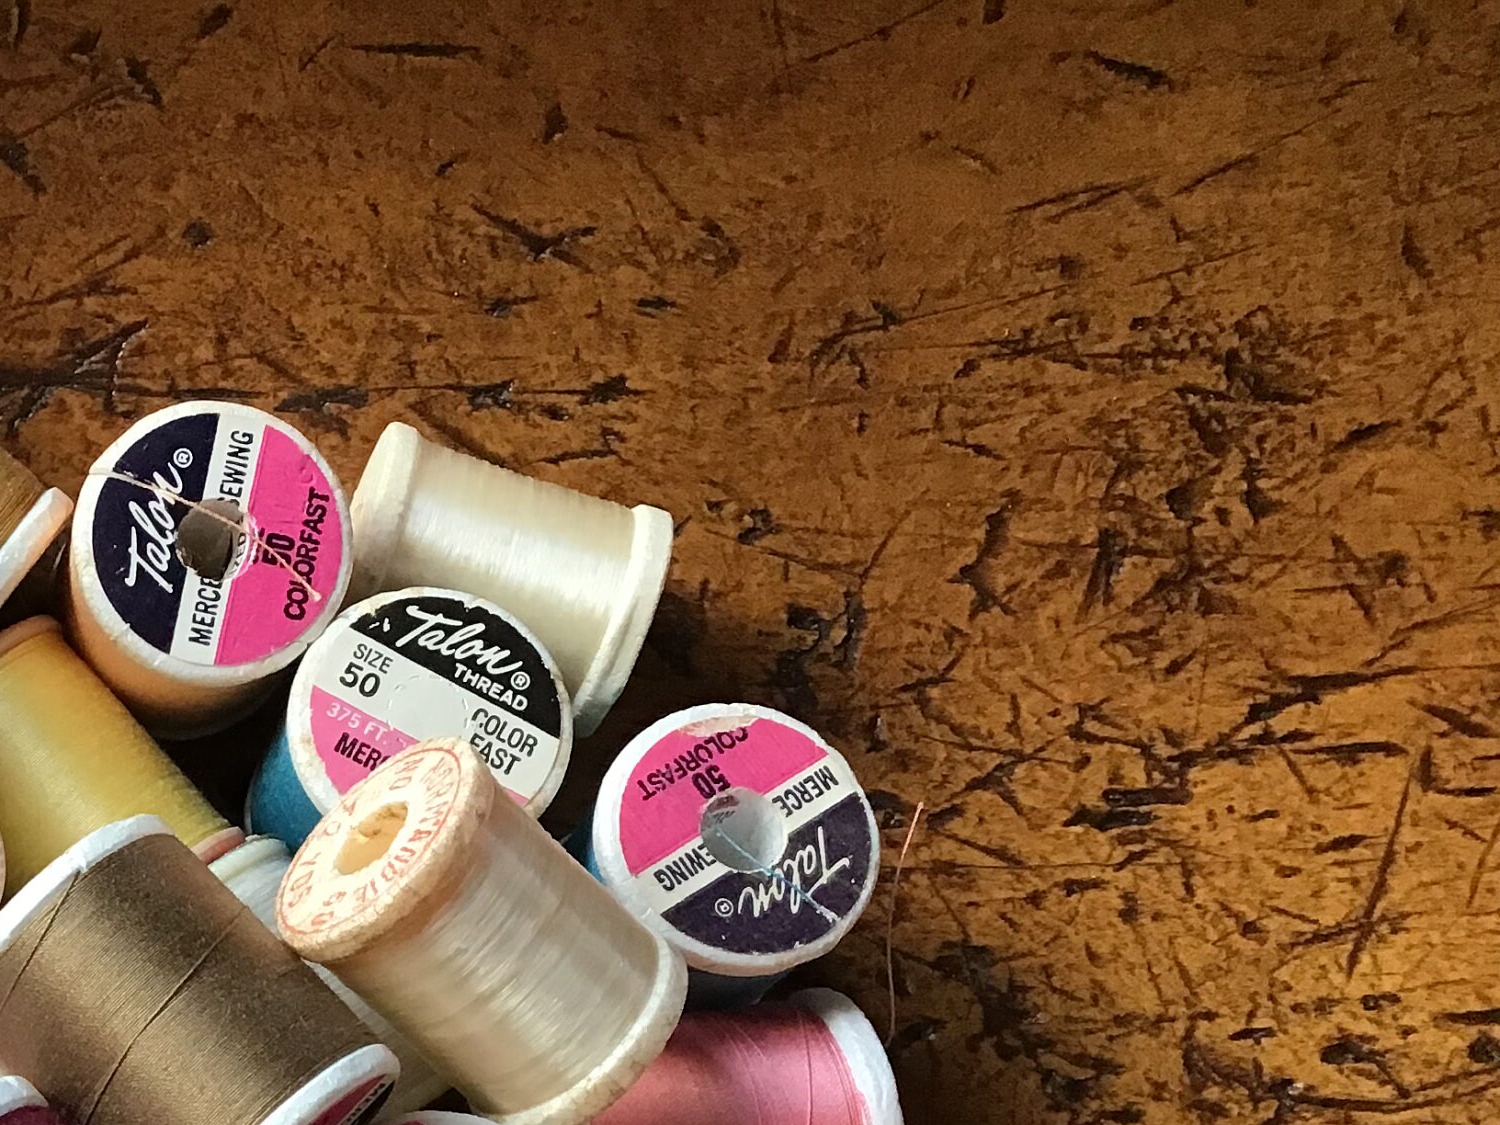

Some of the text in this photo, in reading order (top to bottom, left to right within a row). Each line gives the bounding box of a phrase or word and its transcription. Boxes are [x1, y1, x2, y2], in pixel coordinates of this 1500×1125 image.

[283, 488, 330, 620] COLORFAST
[339, 663, 381, 698] 50
[353, 643, 394, 675] SIZE
[454, 663, 528, 712] THREAD
[326, 701, 360, 728] 375
[471, 707, 539, 758] COLOR
[653, 843, 717, 892] EWING
